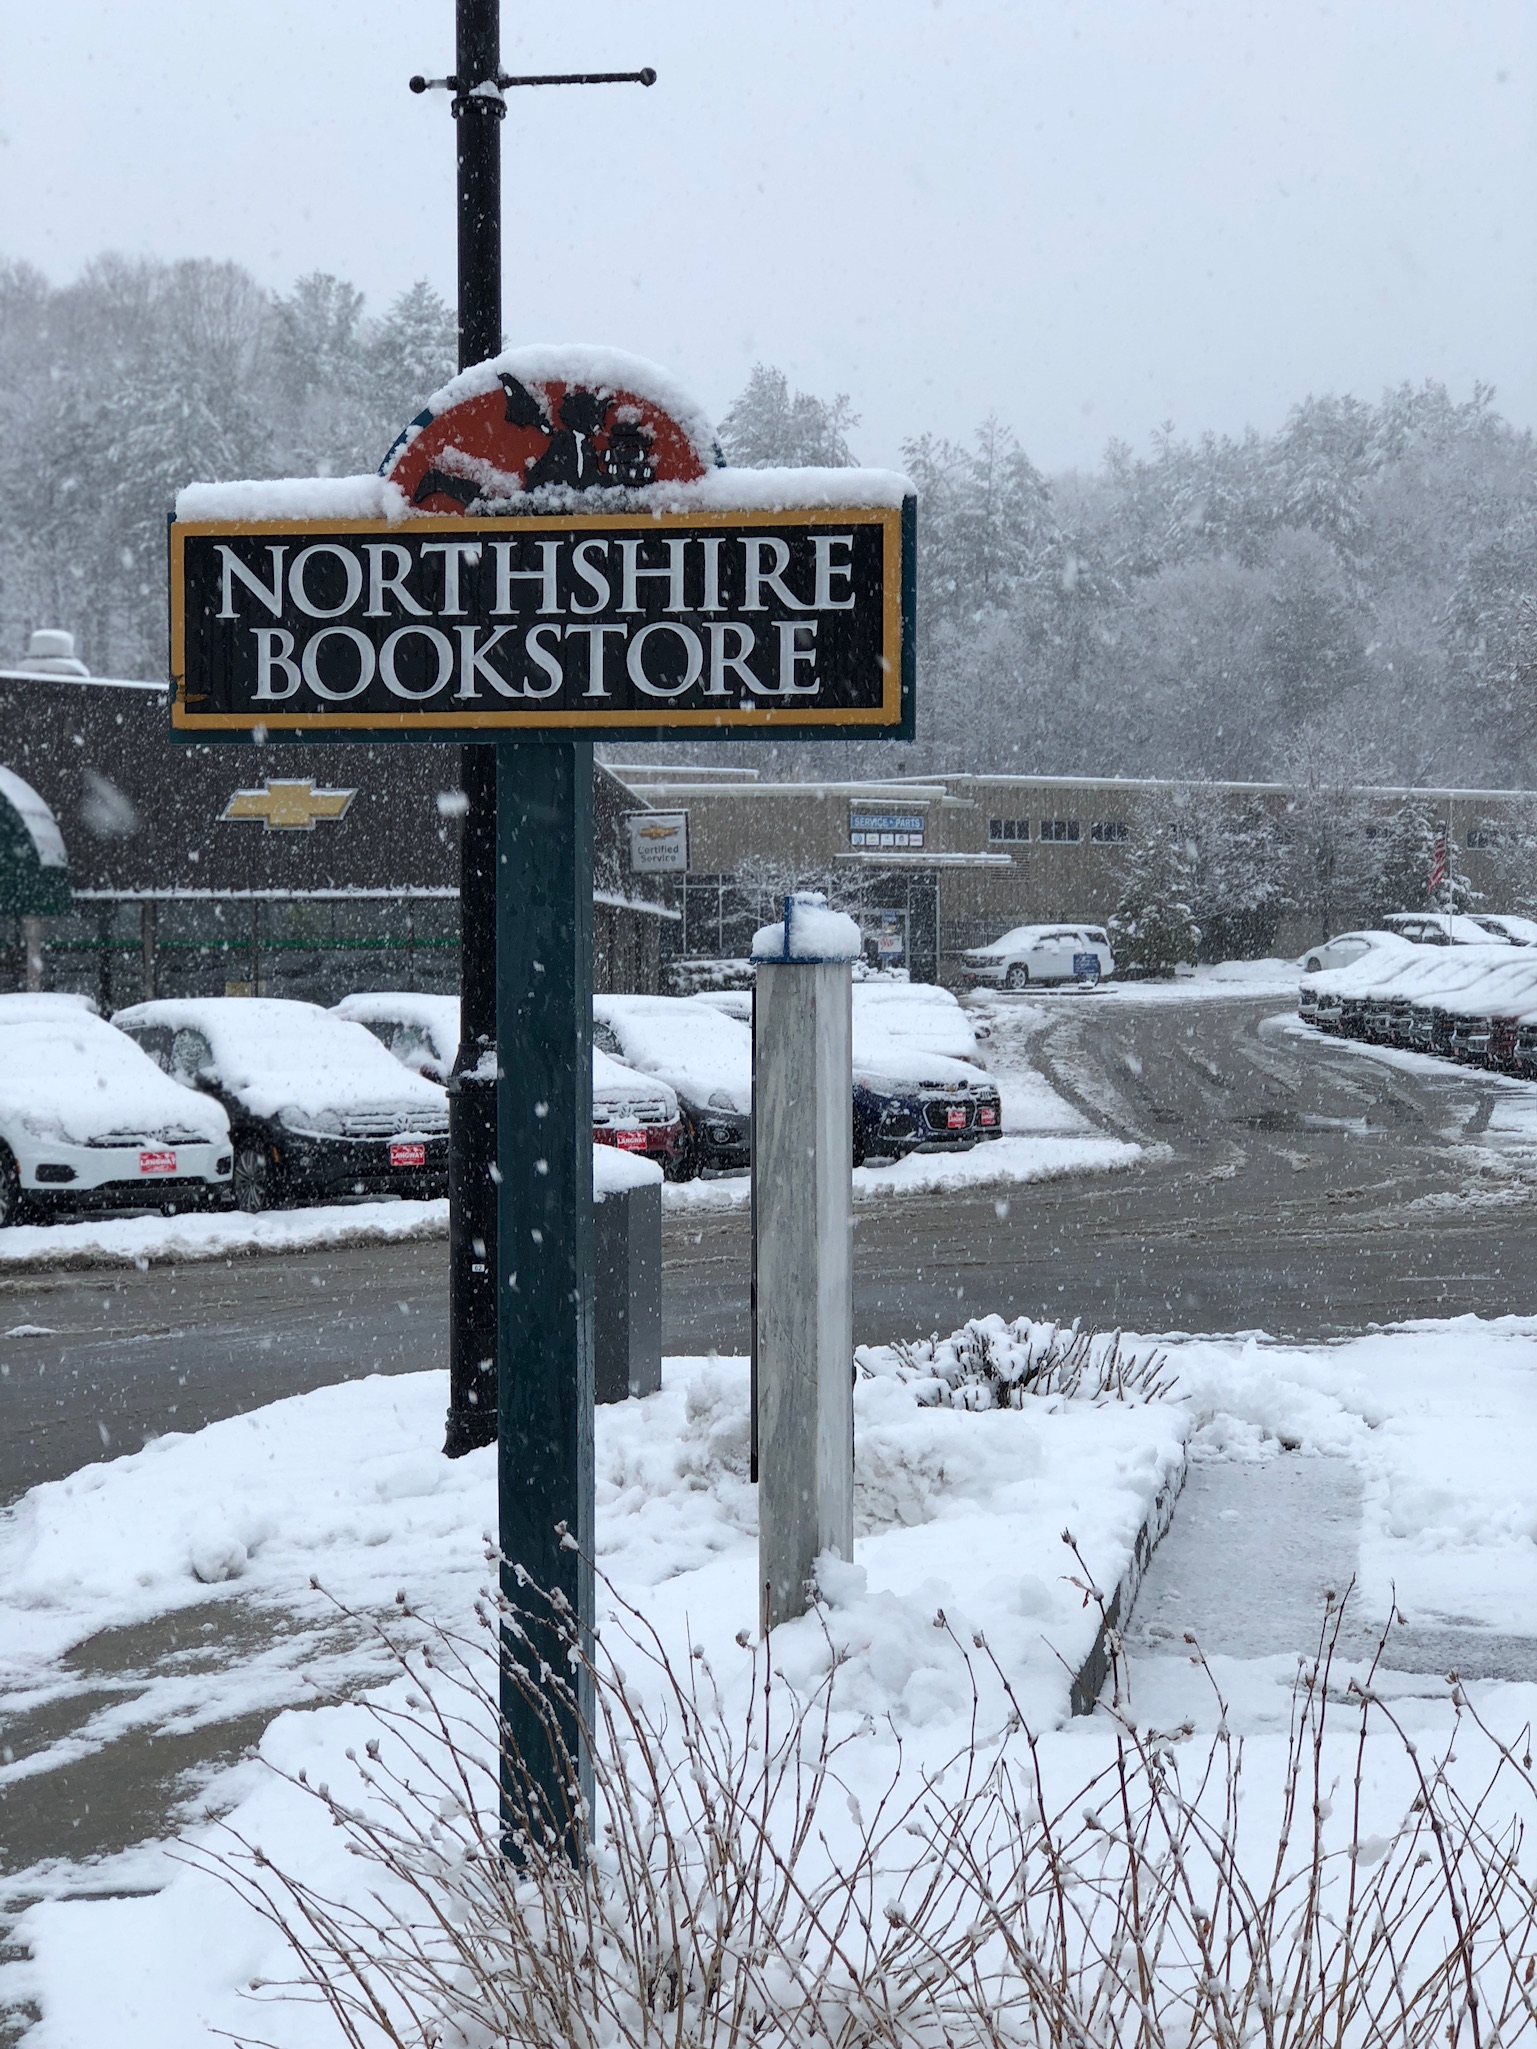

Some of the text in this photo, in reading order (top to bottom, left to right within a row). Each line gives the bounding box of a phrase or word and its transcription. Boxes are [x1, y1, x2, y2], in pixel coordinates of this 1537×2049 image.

[213, 534, 856, 619] NORTHSHIRE
[249, 619, 821, 701] BOOKSTORE
[854, 817, 921, 829] SERVICE PARTS
[637, 844, 679, 855] Certified
[640, 854, 676, 863] Service
